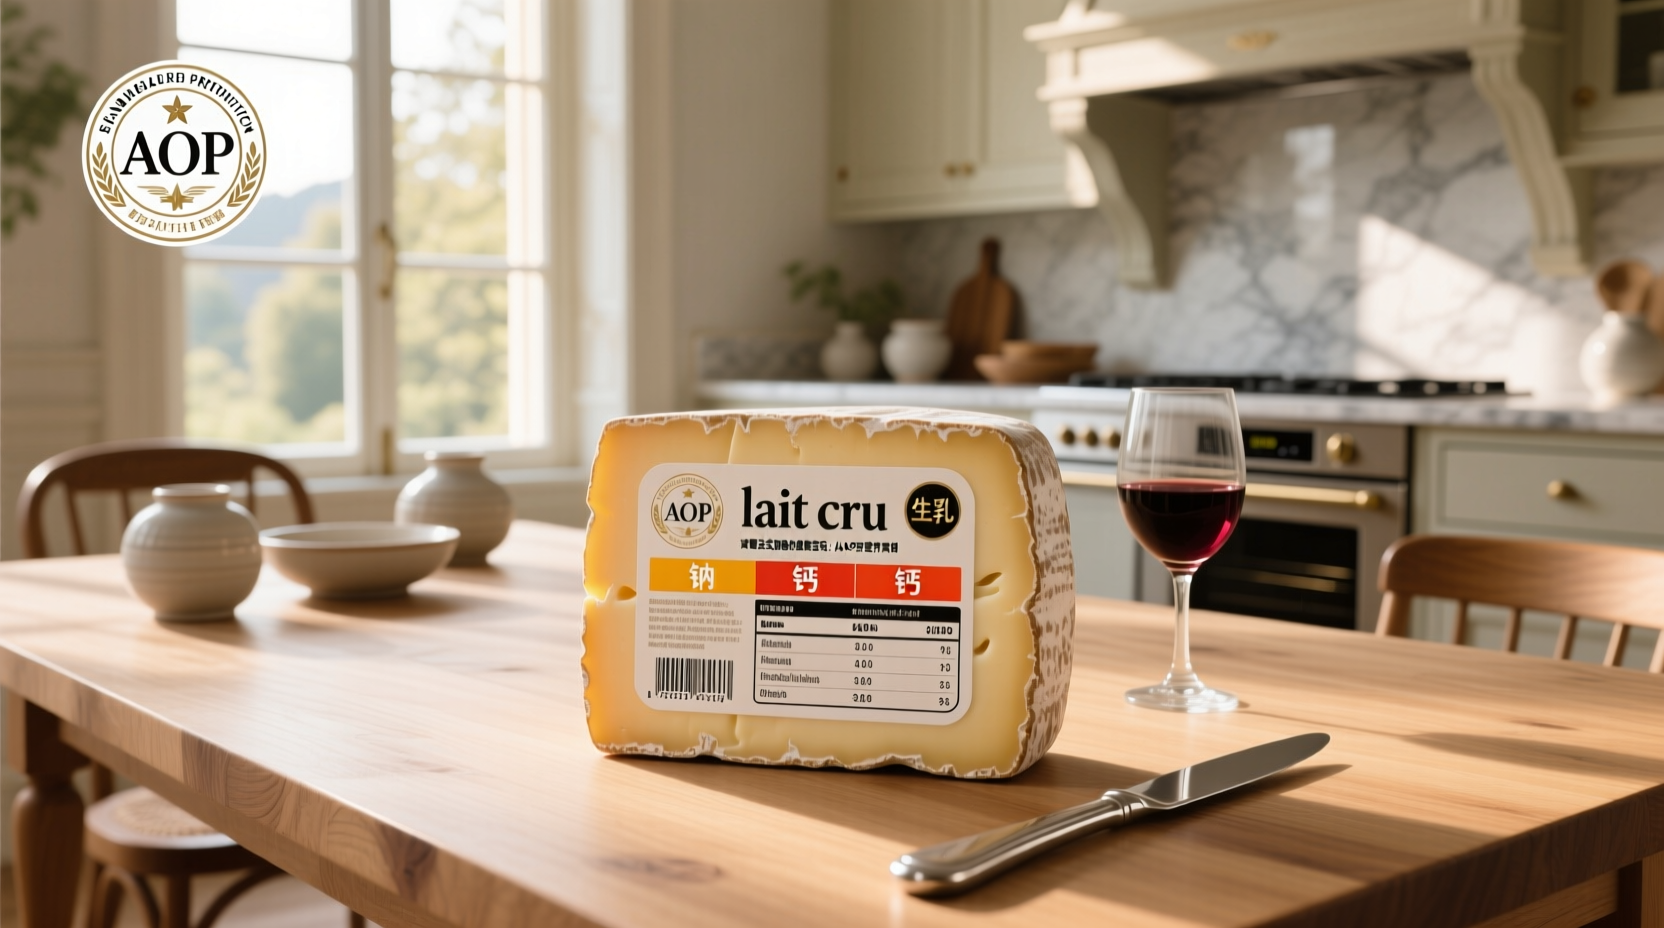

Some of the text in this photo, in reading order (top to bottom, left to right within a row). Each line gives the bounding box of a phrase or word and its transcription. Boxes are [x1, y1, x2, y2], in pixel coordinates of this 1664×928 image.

[664, 502, 712, 523] AOP
[741, 485, 809, 530] lait
[817, 501, 888, 532] cru
[911, 496, 955, 525] 生乳
[689, 562, 715, 591] 钠
